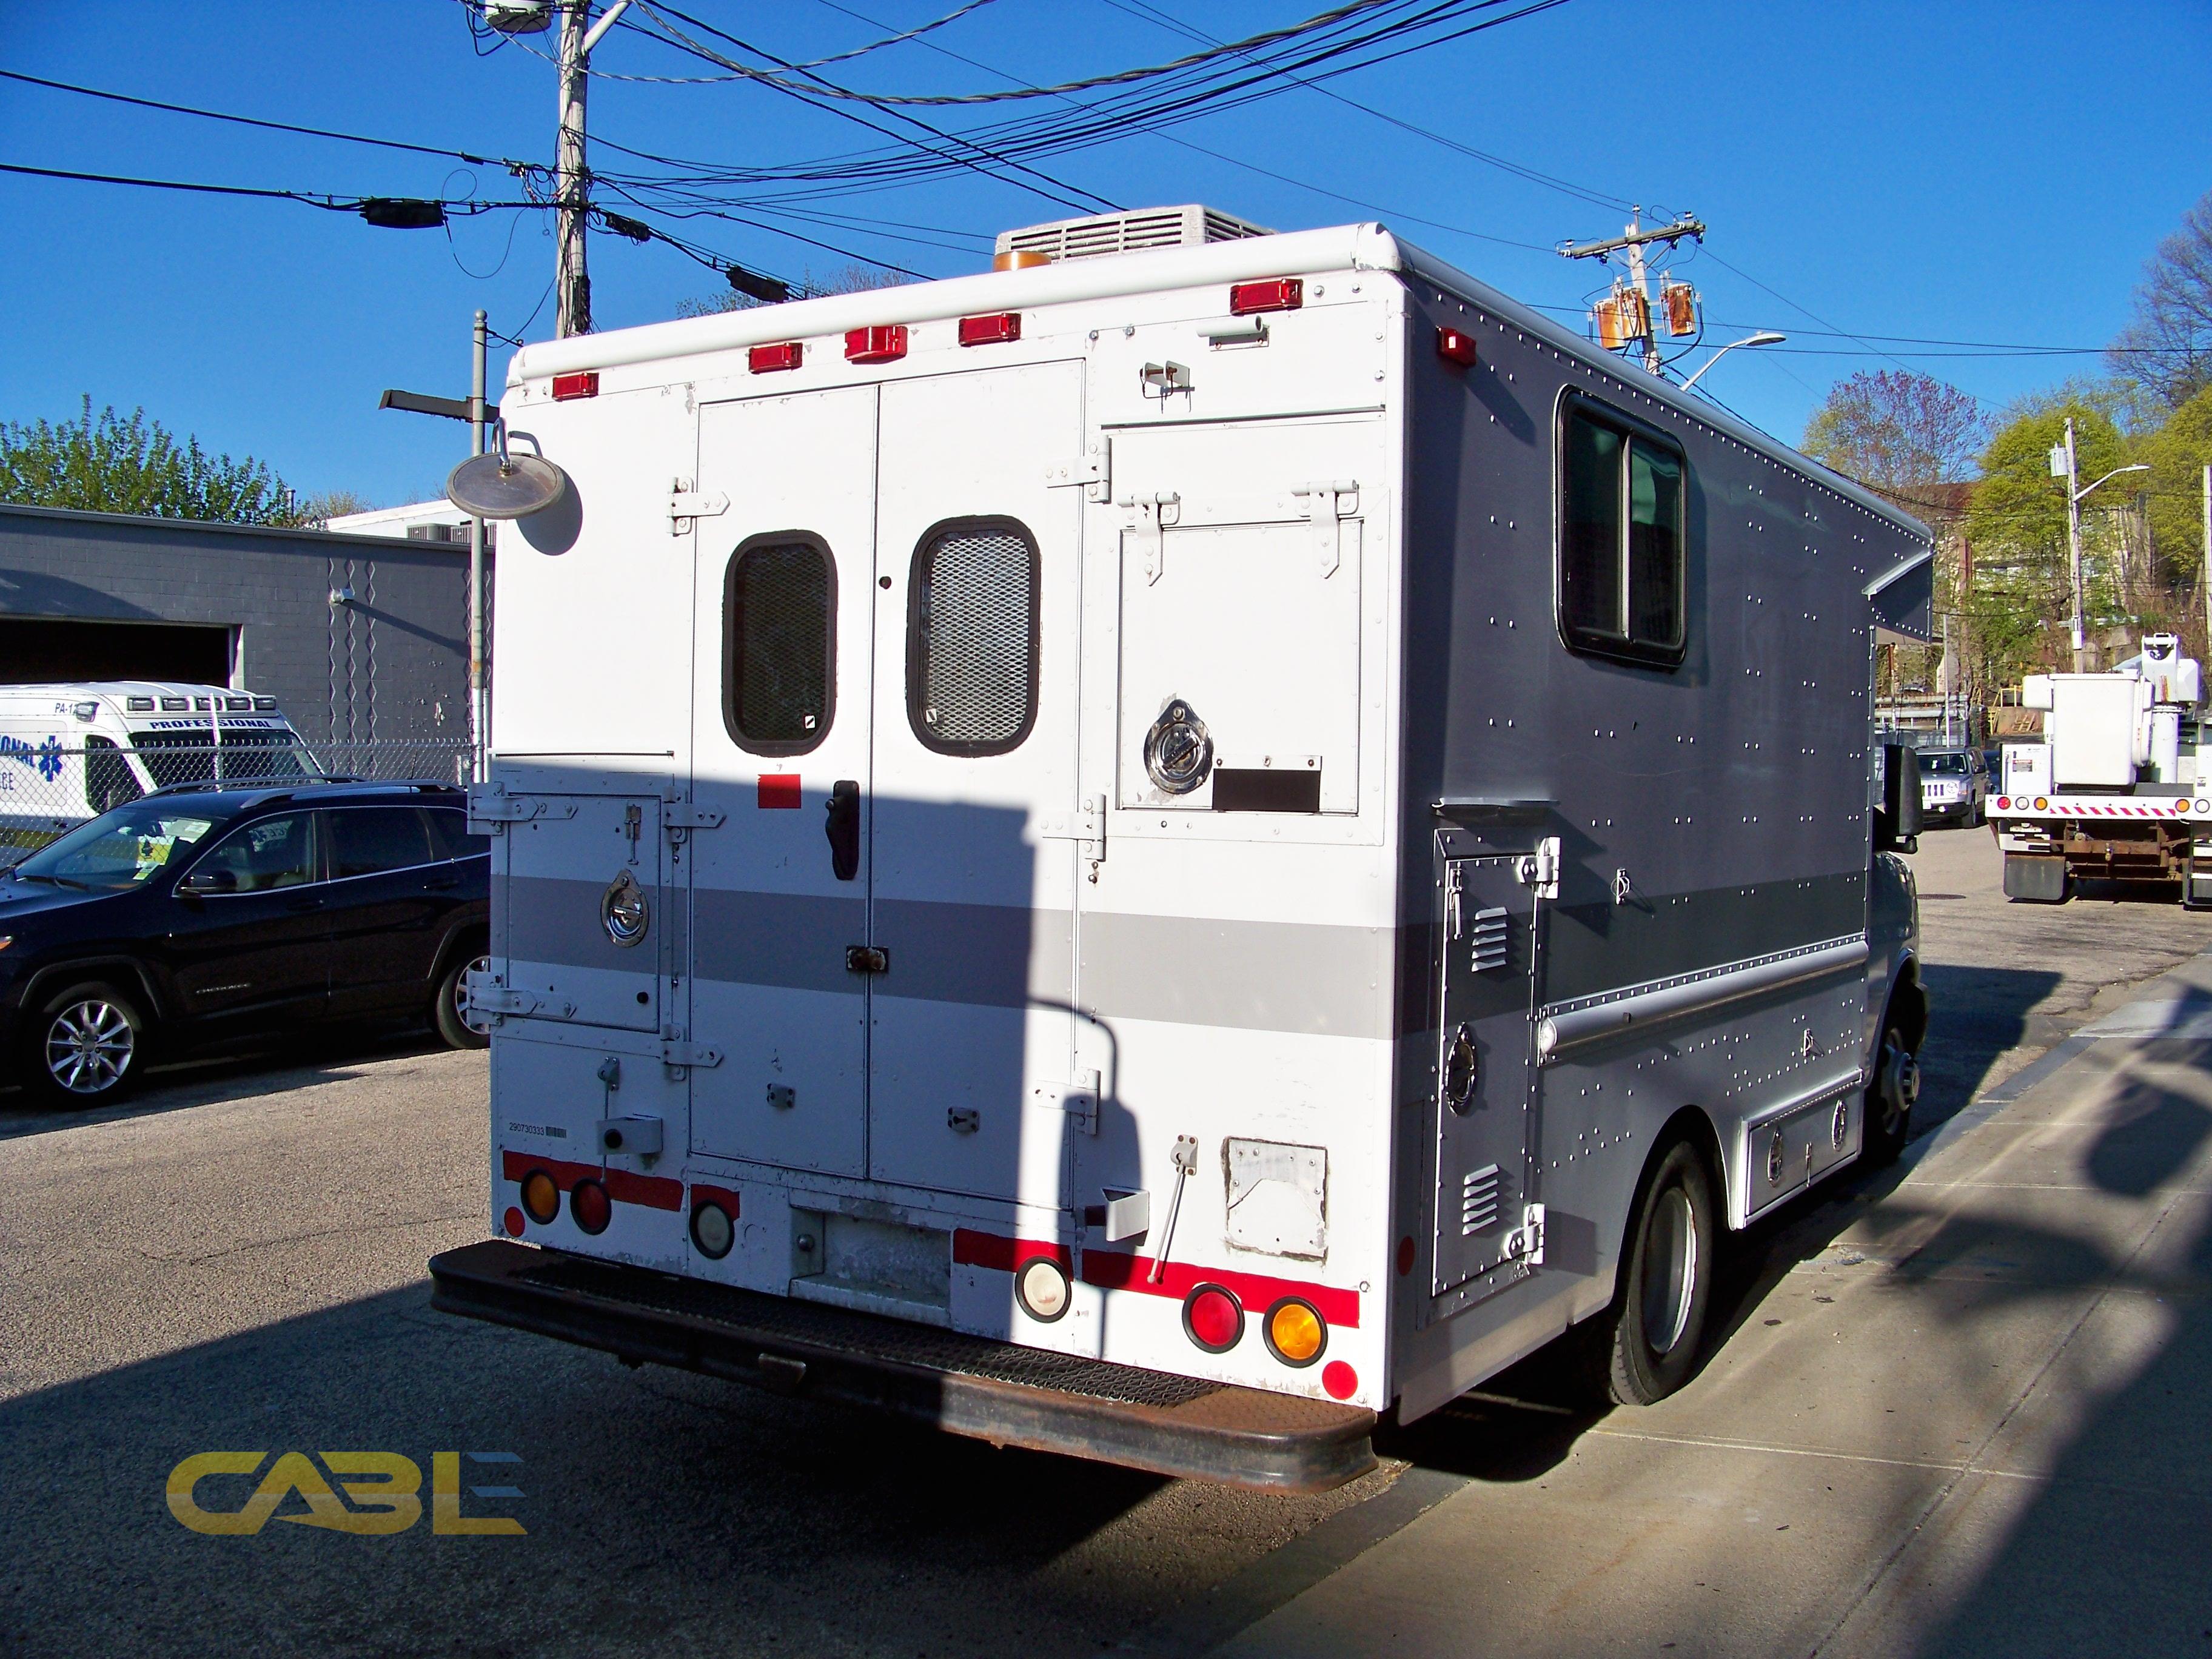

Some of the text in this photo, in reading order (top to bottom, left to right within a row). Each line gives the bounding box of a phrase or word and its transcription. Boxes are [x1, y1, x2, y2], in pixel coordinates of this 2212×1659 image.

[149, 719, 272, 729] PROFESSIONAL
[0, 735, 35, 768] ONAL
[509, 1122, 545, 1136] 290730333
